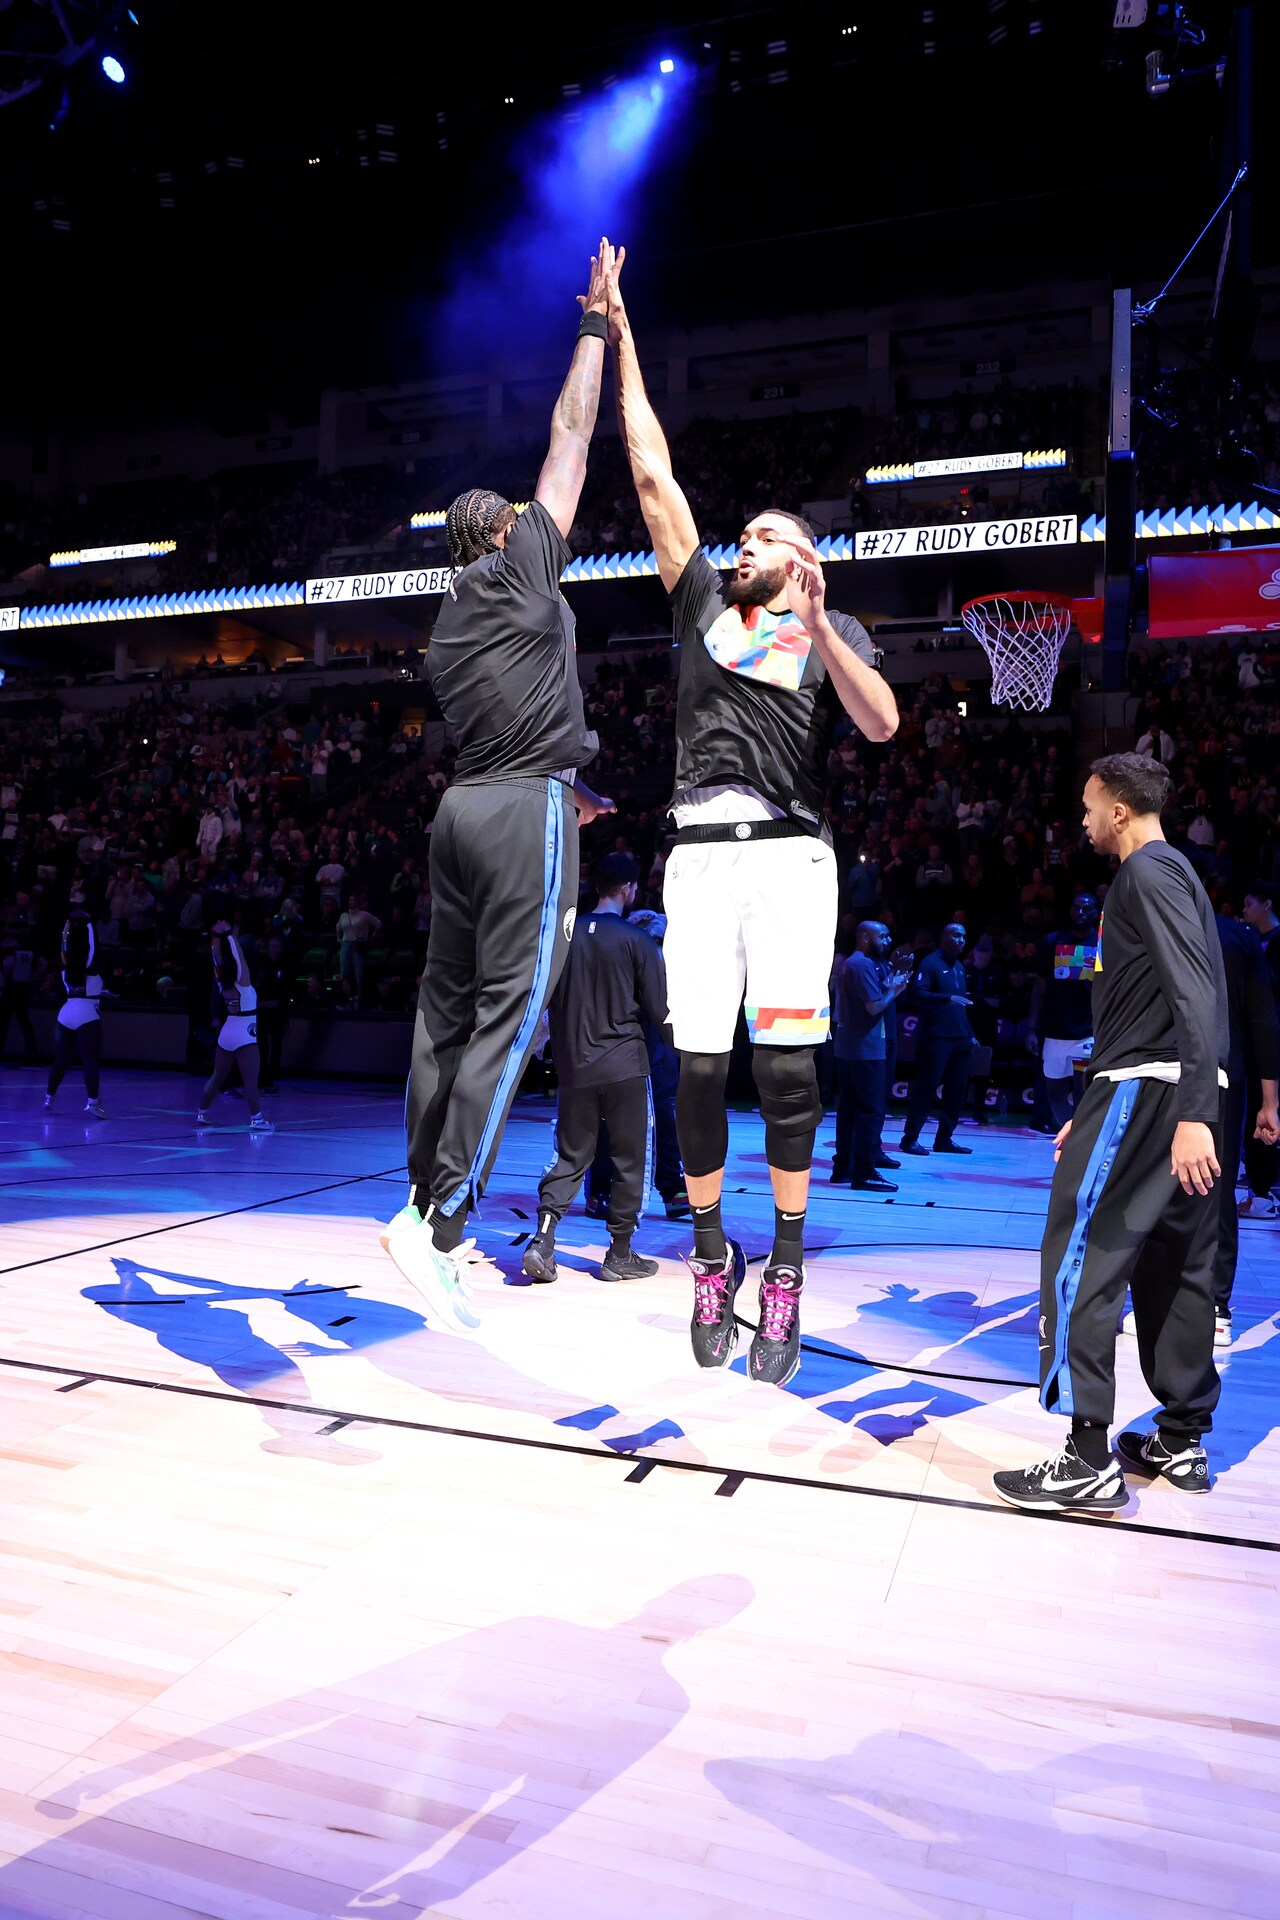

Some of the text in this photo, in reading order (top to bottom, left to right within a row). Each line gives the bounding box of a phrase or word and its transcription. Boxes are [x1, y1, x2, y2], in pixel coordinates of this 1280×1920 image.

[976, 361, 1000, 375] 232
[763, 385, 784, 399] 231
[918, 454, 1020, 474] #27 RUDY GOBERT
[861, 518, 1074, 556] #27 RUDY GOBERT
[311, 570, 447, 601] #27 RUDY GOBE
[903, 1015, 919, 1031] G
[891, 1081, 909, 1099] G
